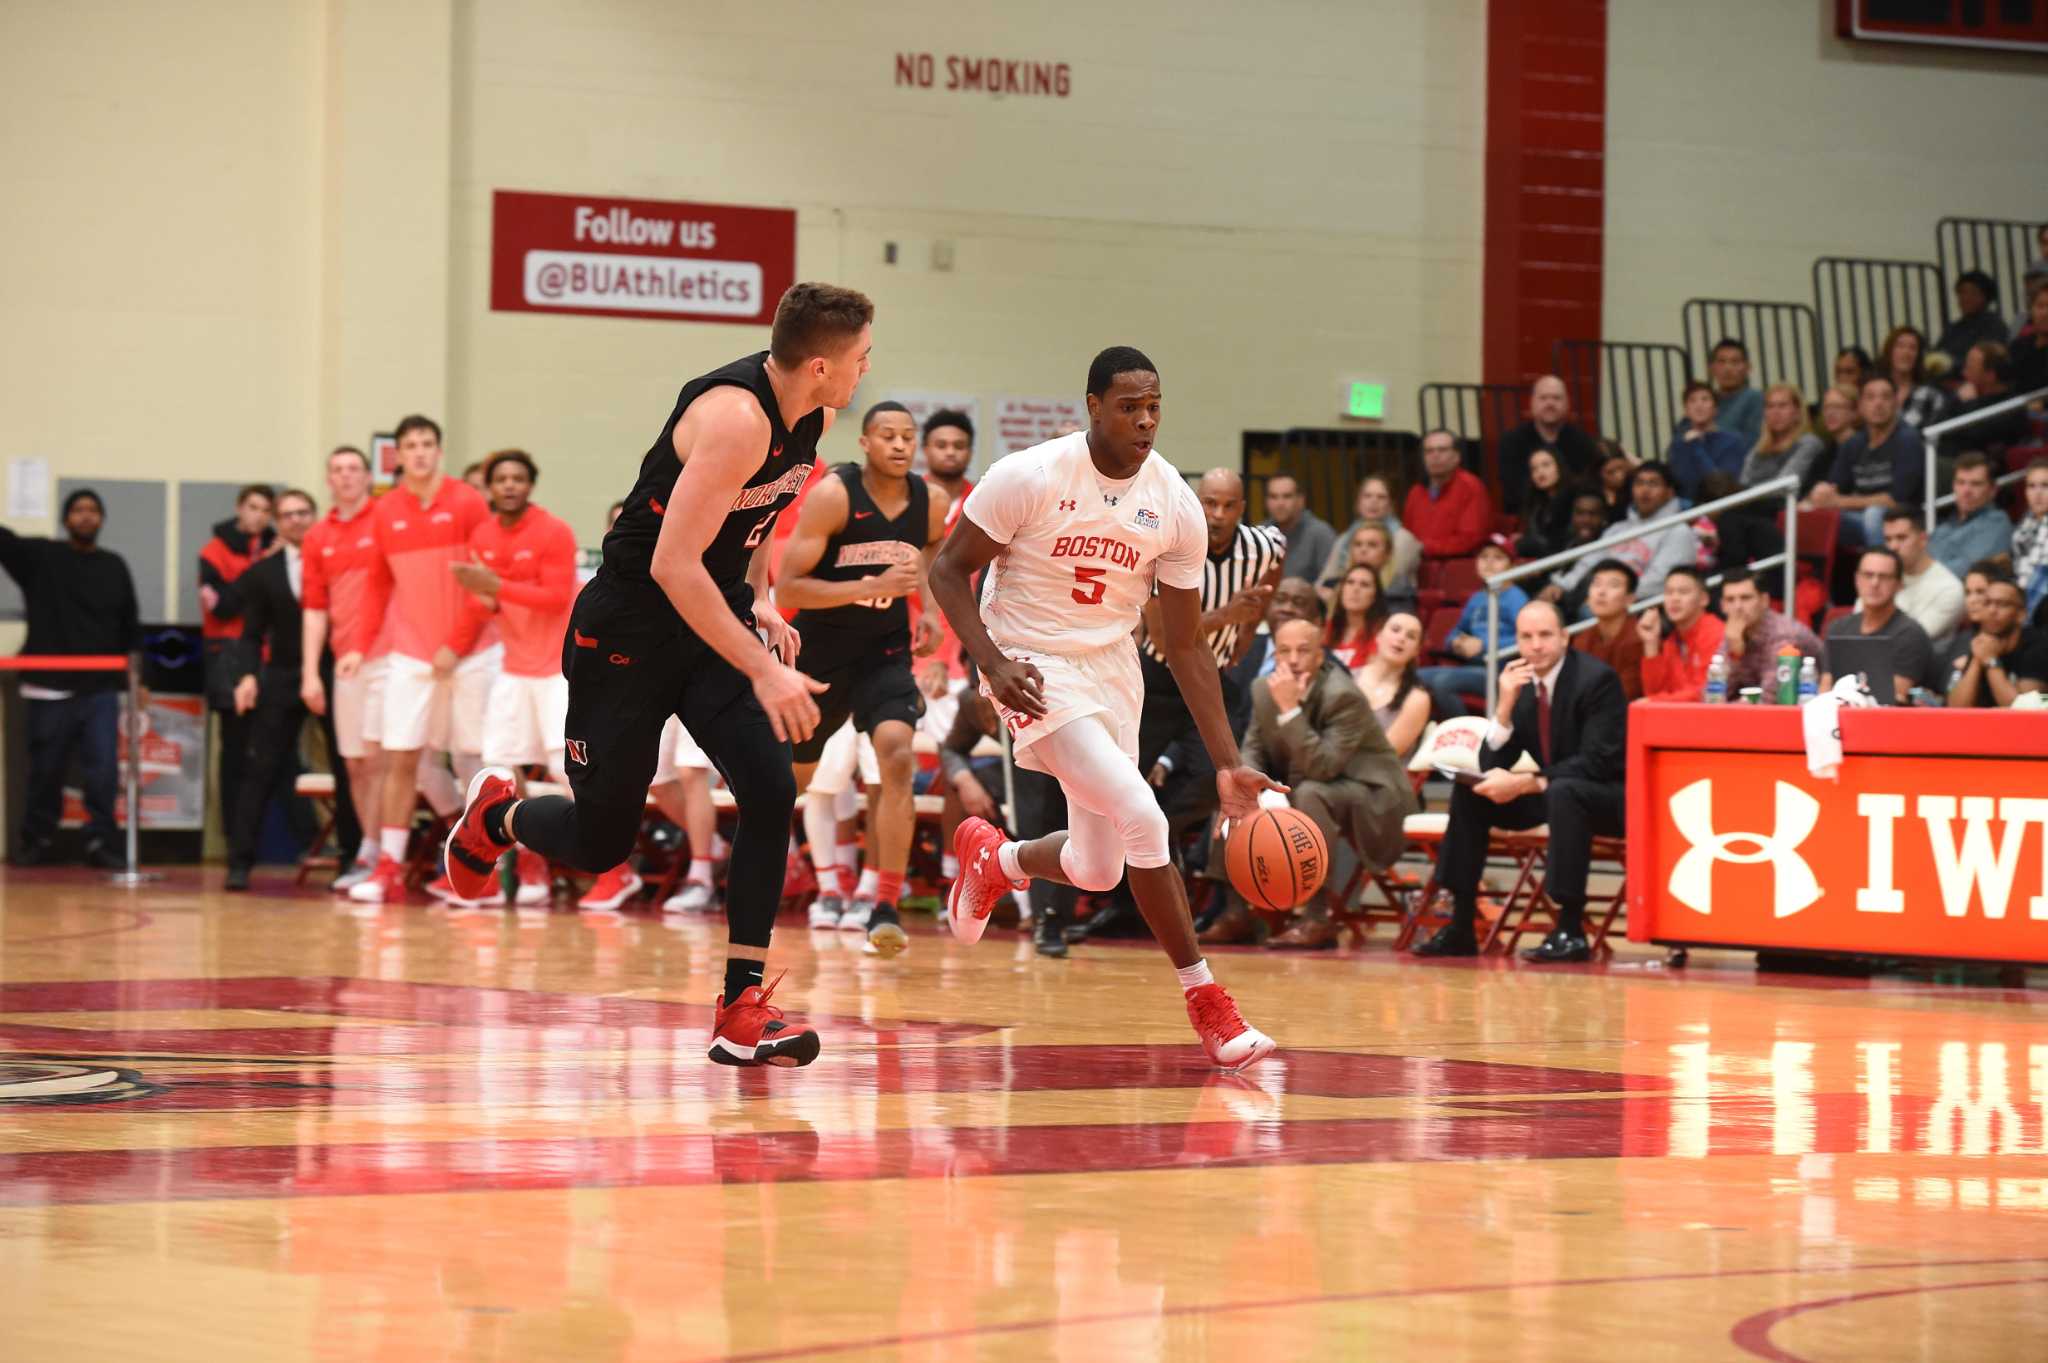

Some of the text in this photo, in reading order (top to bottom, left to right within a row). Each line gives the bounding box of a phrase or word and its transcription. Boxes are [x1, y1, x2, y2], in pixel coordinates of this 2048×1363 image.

[895, 53, 1070, 98] NO SMOKING
[574, 206, 716, 249] Follow us
[536, 261, 750, 303] @BUAthletics
[1050, 535, 1141, 571] BOSTON
[1071, 566, 1106, 605] 5
[1856, 793, 1905, 913] I
